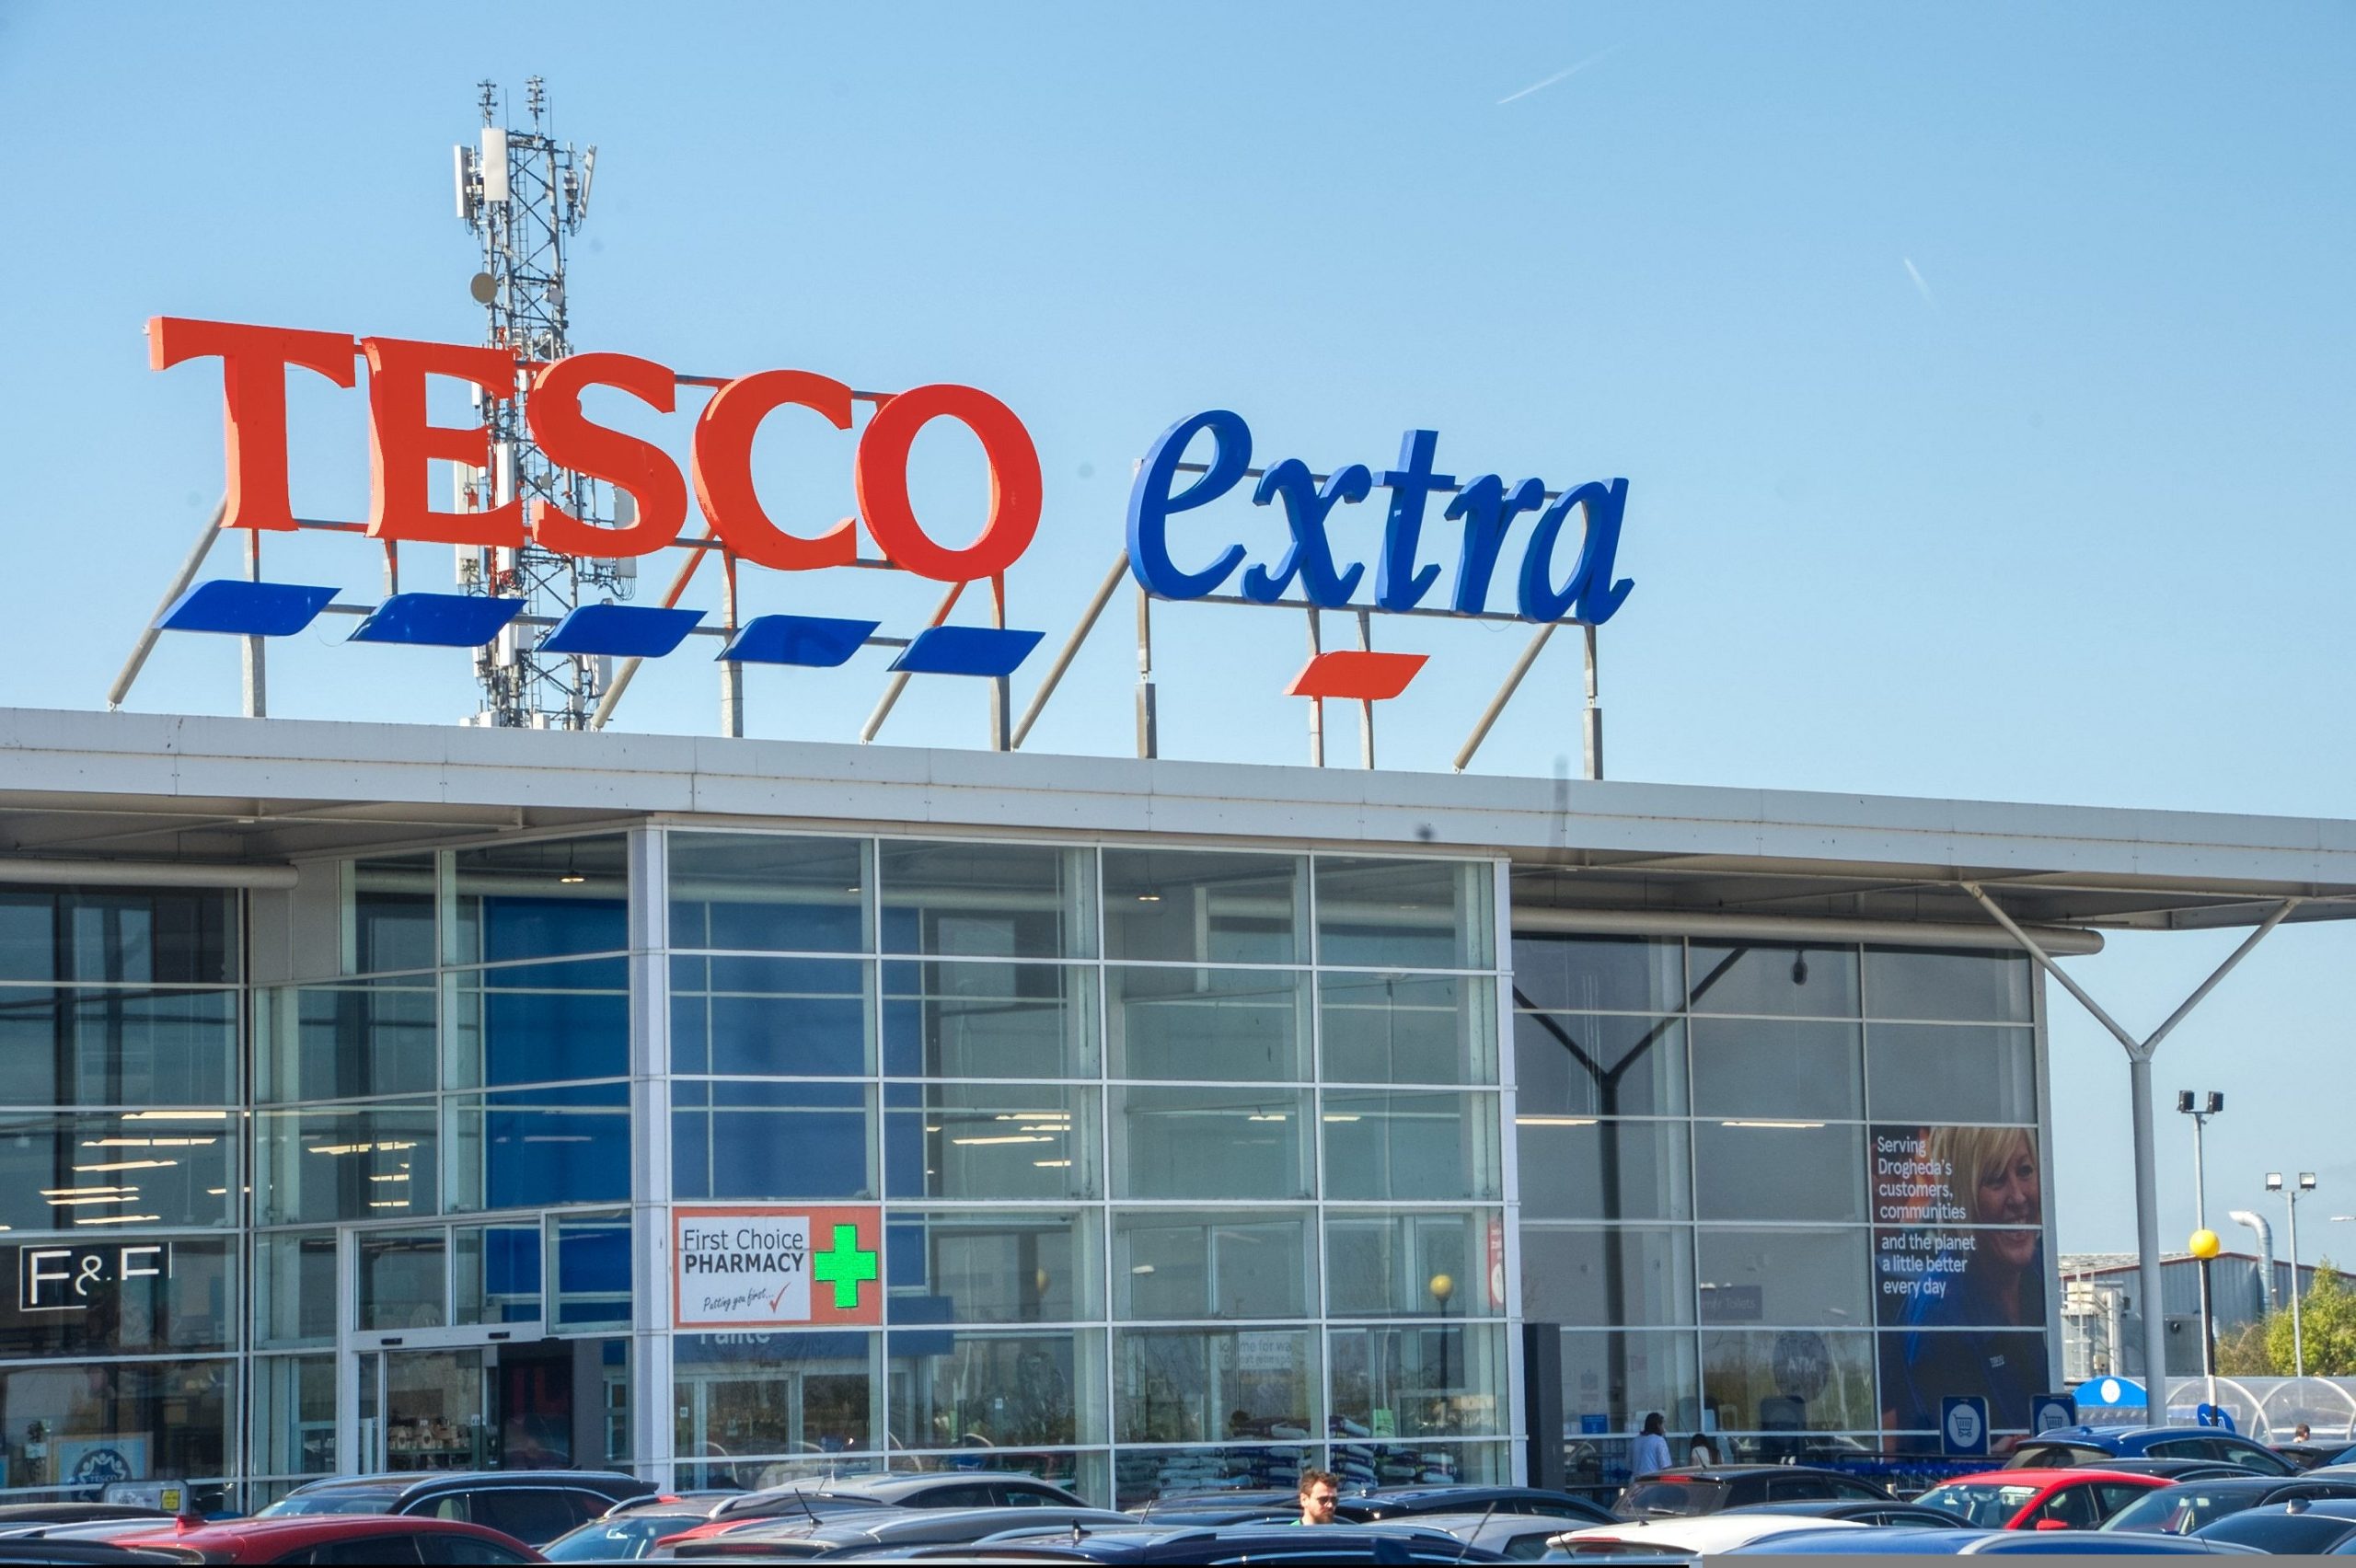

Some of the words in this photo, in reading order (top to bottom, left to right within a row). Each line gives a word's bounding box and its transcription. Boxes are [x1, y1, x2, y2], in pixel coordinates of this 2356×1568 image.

[149, 316, 1043, 582] TESCO
[1125, 409, 1635, 626] extra
[1877, 1136, 1926, 1158] Serving
[1878, 1158, 1952, 1179] Drogheda's
[1879, 1182, 1953, 1200] customers,
[1880, 1203, 1967, 1219] communities
[684, 1229, 729, 1251] First
[736, 1228, 803, 1250] Choice
[1881, 1233, 1906, 1250] and
[1909, 1233, 1932, 1250] the
[1934, 1233, 1977, 1254] planet
[685, 1252, 804, 1274] PHARMACY
[1882, 1259, 1890, 1272] a
[1893, 1254, 1923, 1272] little
[1926, 1254, 1968, 1273] better
[1883, 1280, 1921, 1298] every
[1923, 1277, 1946, 1298] day
[703, 1297, 731, 1311] Putting
[732, 1296, 746, 1310] you
